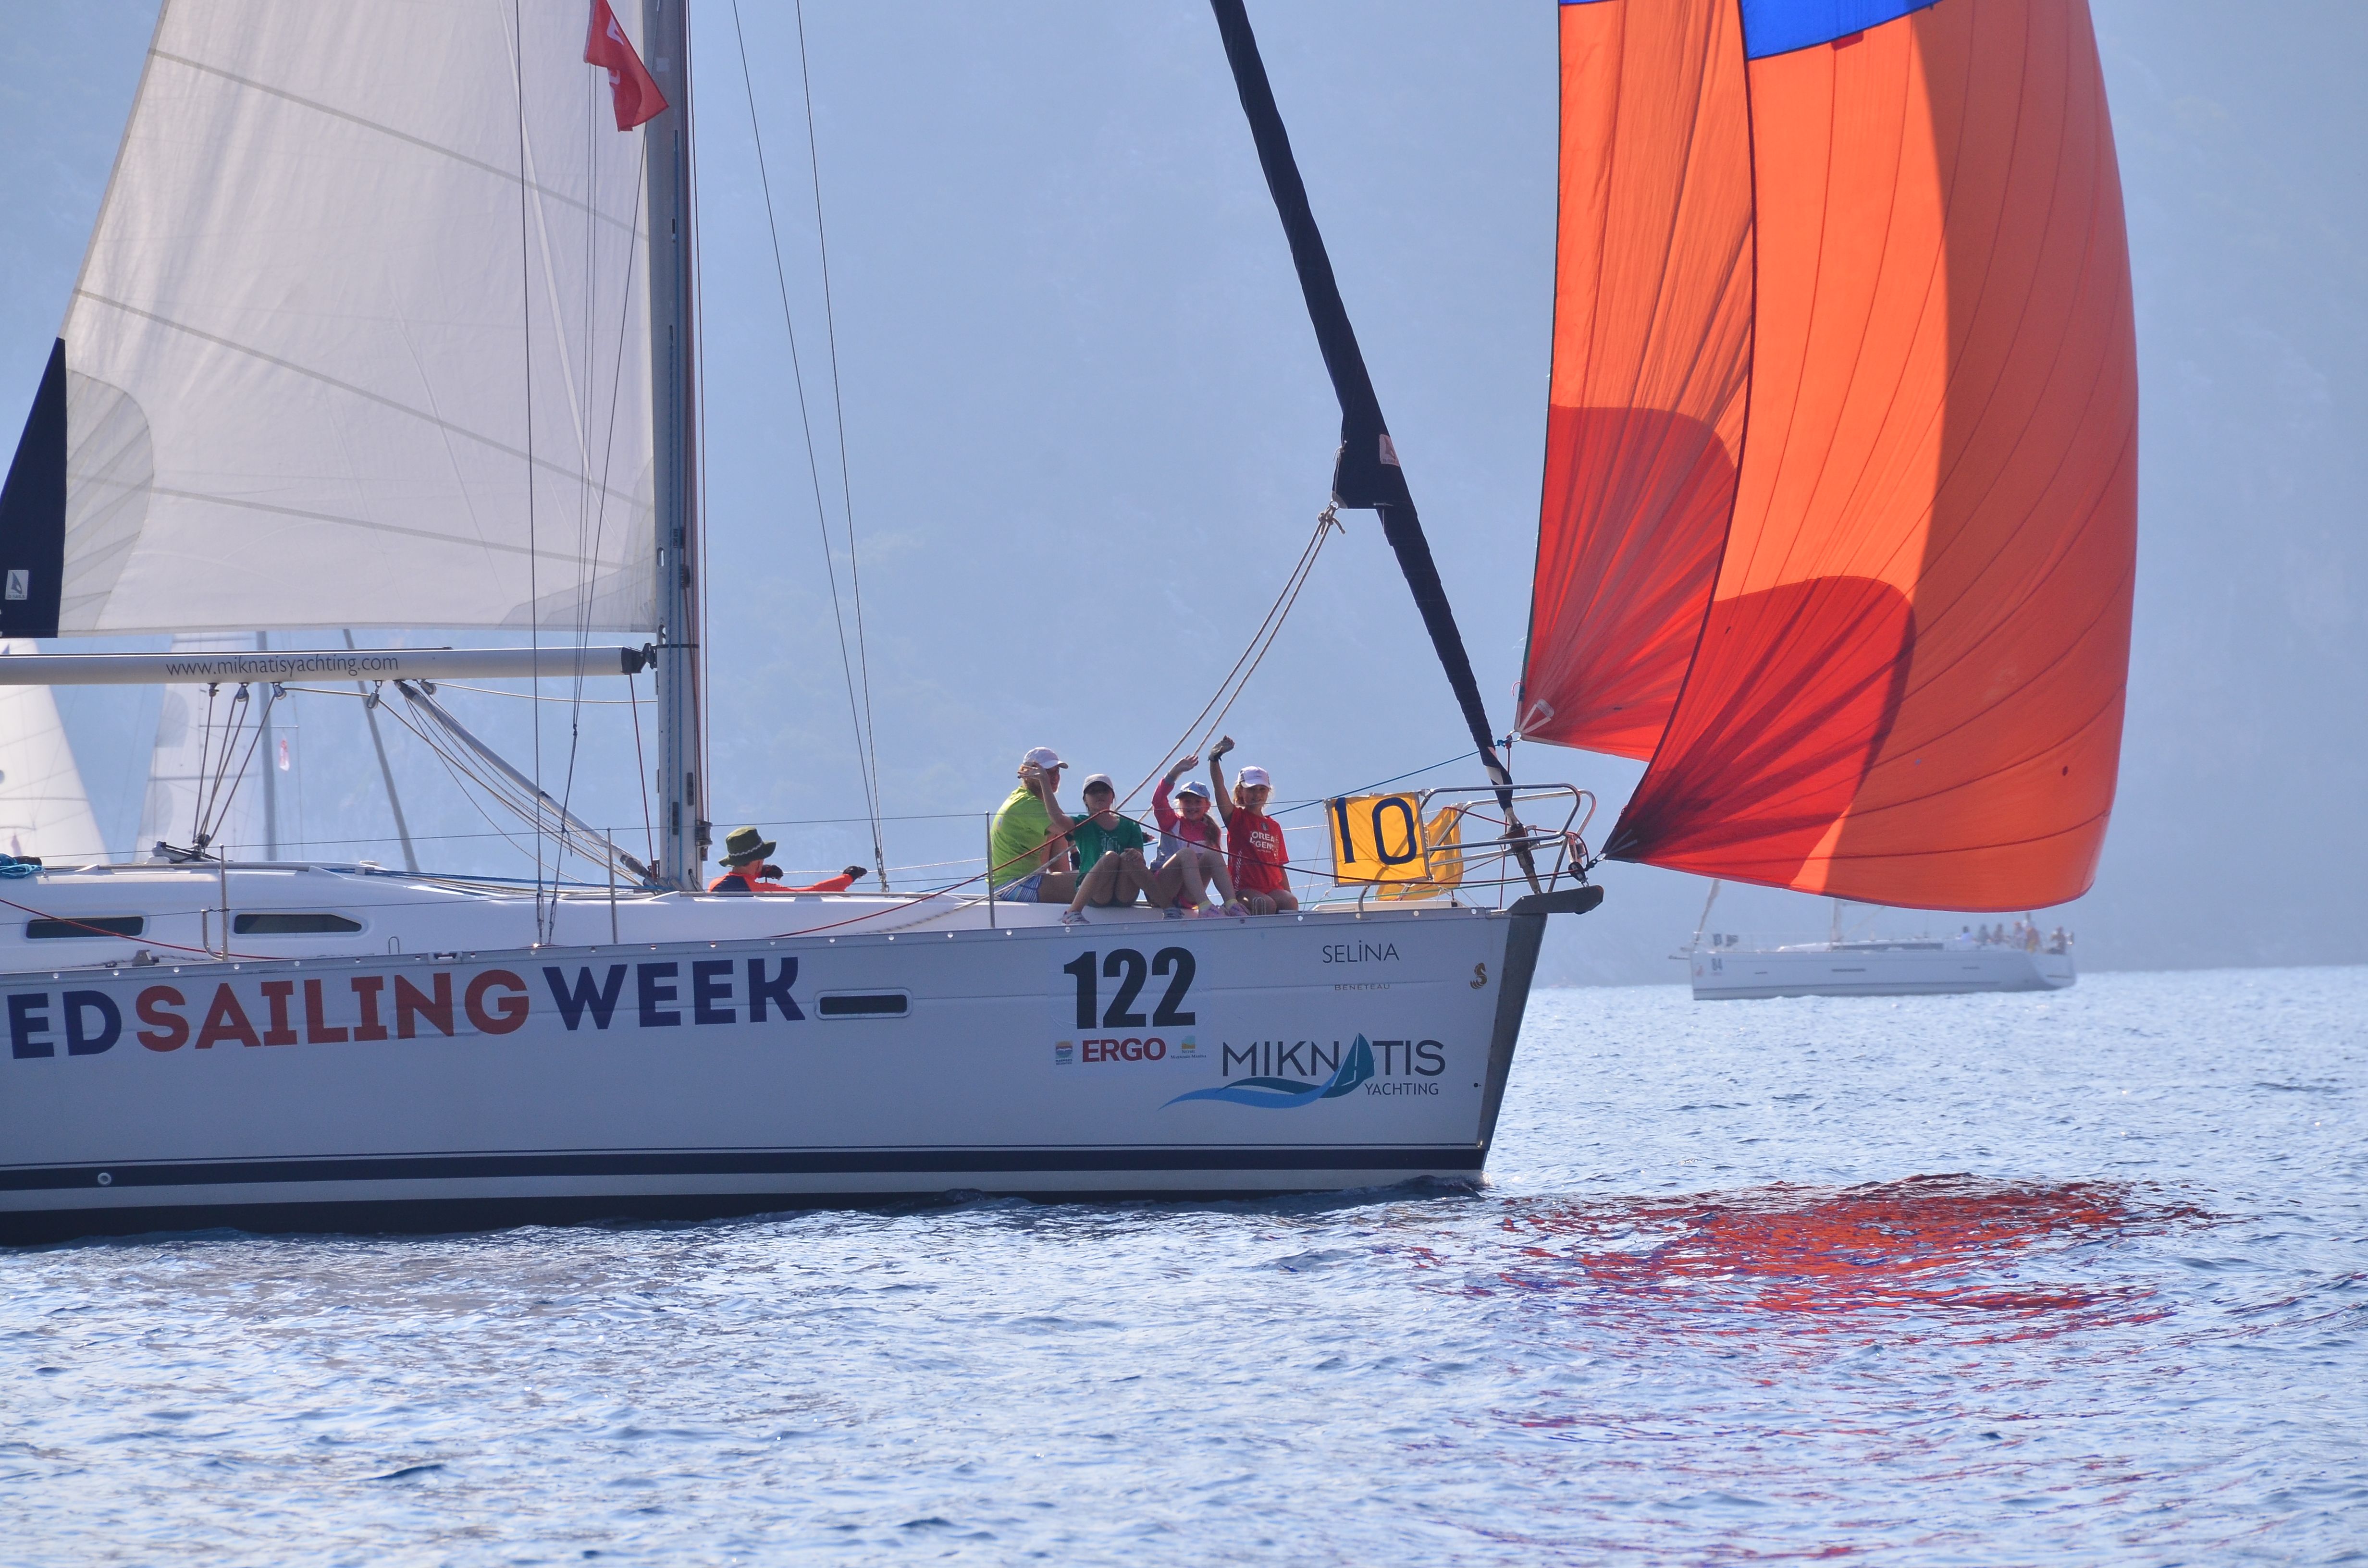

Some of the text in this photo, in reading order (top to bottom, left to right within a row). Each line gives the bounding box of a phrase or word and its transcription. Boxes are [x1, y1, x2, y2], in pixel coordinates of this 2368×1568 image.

[166, 654, 398, 676] www.miknatisyachting.com
[1250, 831, 1275, 843] OREA
[1334, 797, 1417, 865] 10
[1063, 946, 1196, 1029] 122
[7, 956, 806, 1059] ED SAILING WEEK
[1082, 1038, 1166, 1063] ERGO
[1365, 1082, 1439, 1096] YACHTING
